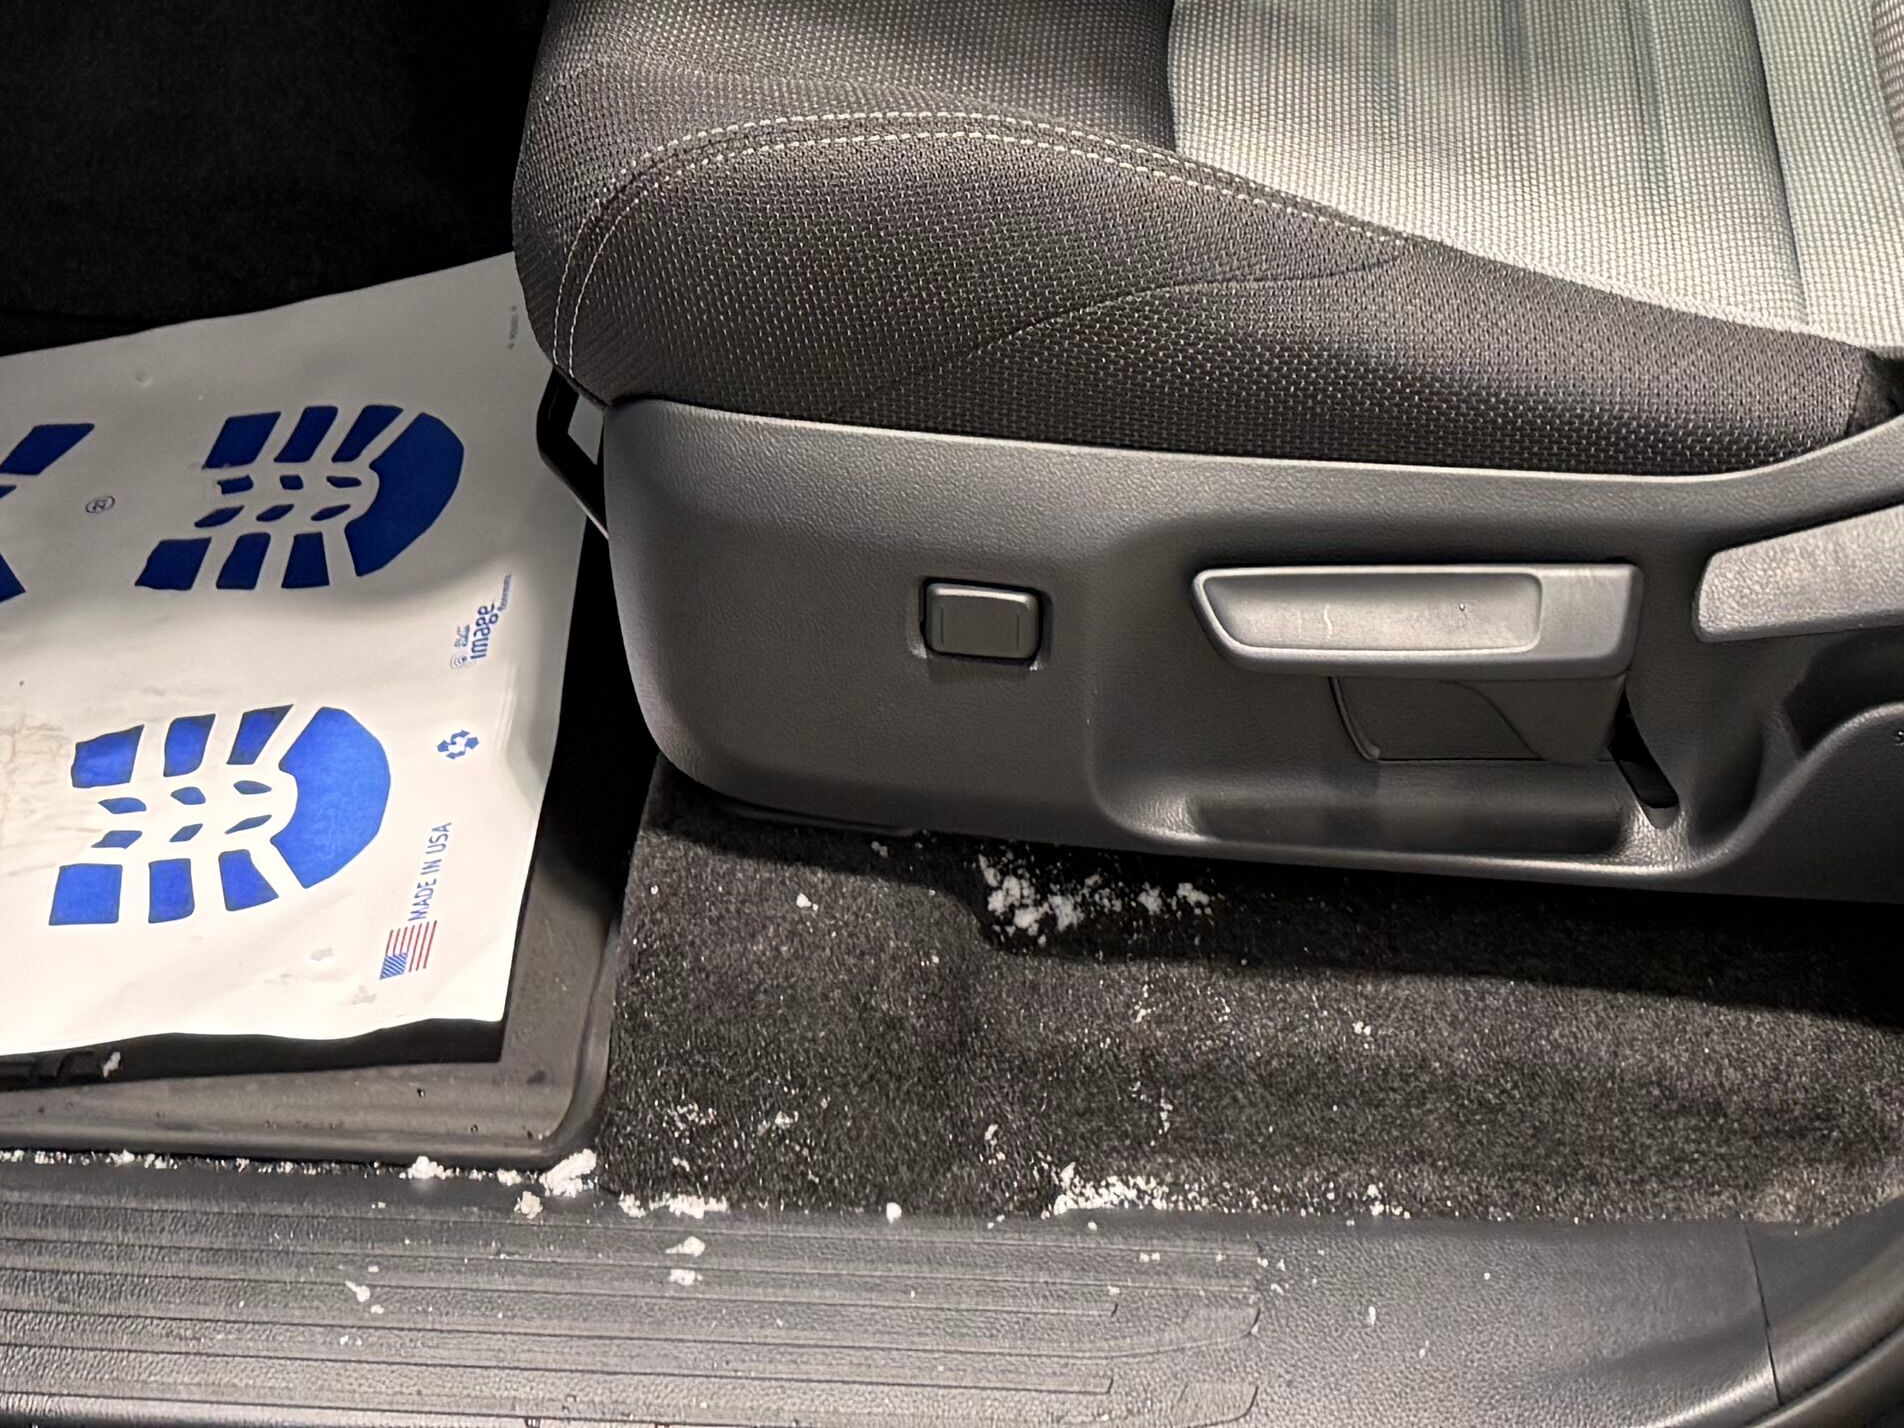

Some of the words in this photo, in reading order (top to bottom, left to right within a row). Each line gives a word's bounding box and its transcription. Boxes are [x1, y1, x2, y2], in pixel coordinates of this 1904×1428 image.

[425, 822, 452, 852] USA
[420, 858, 442, 874] IN
[406, 878, 437, 921] MADE
